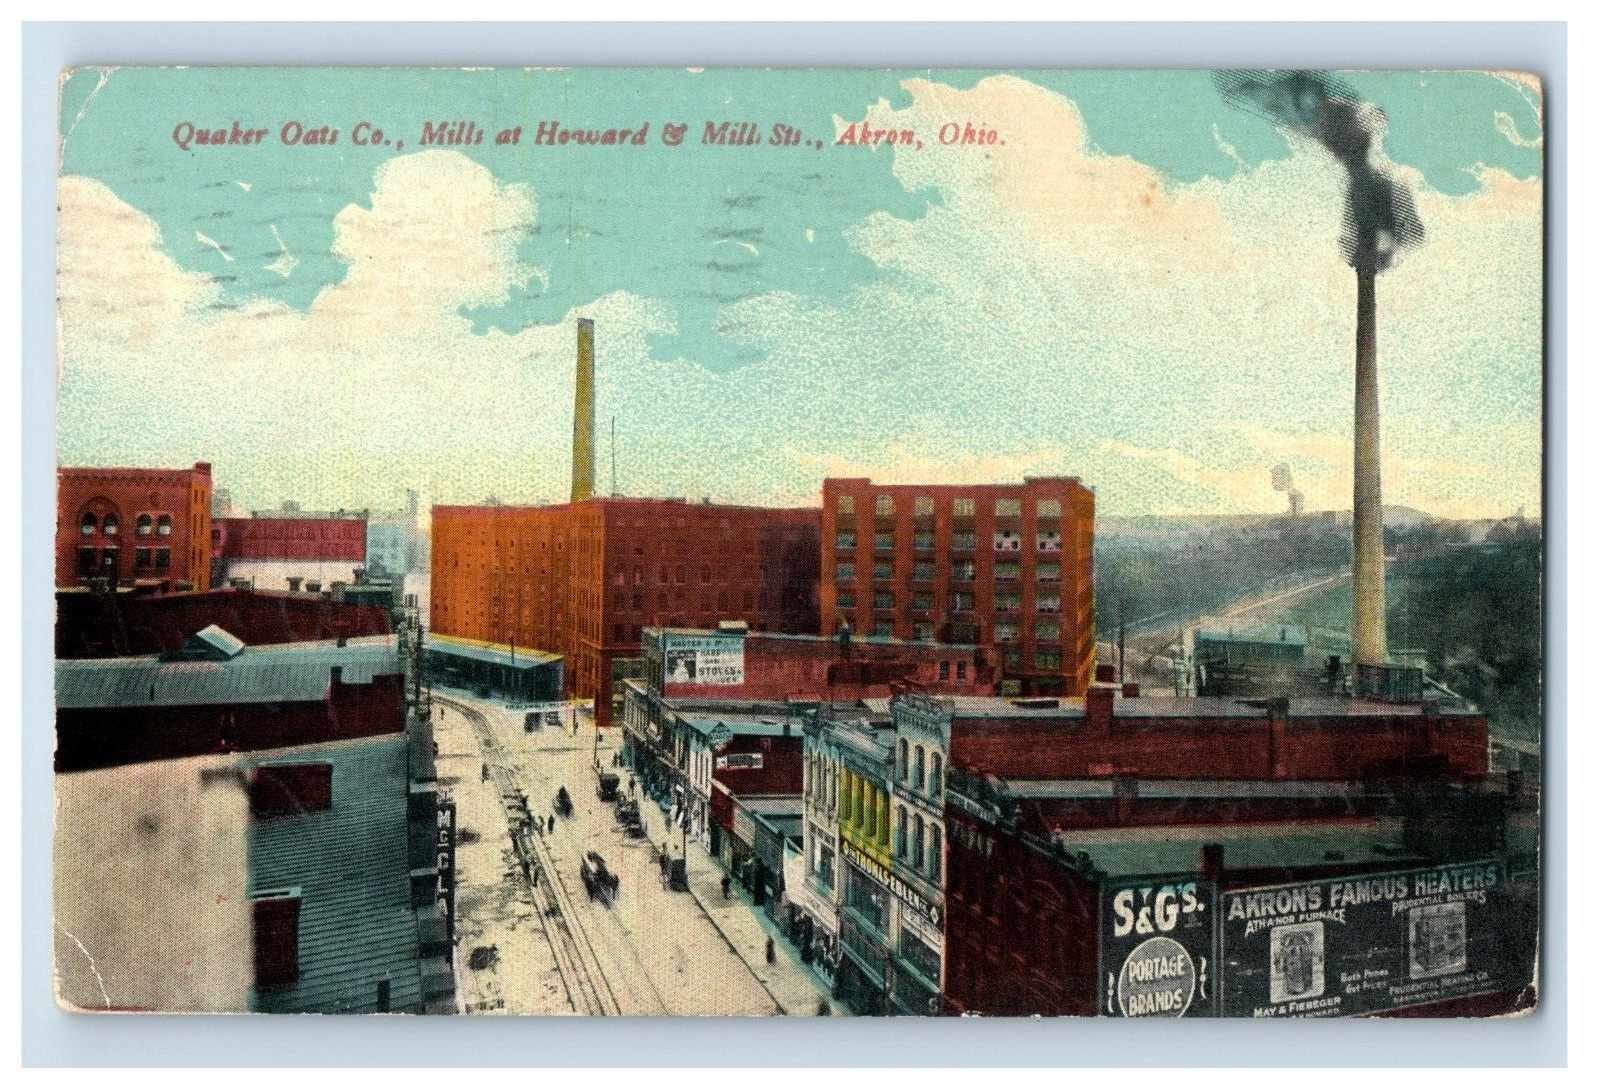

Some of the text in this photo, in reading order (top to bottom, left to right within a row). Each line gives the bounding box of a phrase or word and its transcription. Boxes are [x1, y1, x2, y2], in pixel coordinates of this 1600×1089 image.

[1330, 877, 1409, 908] FAMOUS
[1415, 865, 1498, 897] HEATERS
[1299, 908, 1346, 926] FURNACE
[1128, 954, 1186, 982] PORTAGE
[1128, 988, 1183, 1017] BRANDS
[1253, 1004, 1277, 1018] MAY
